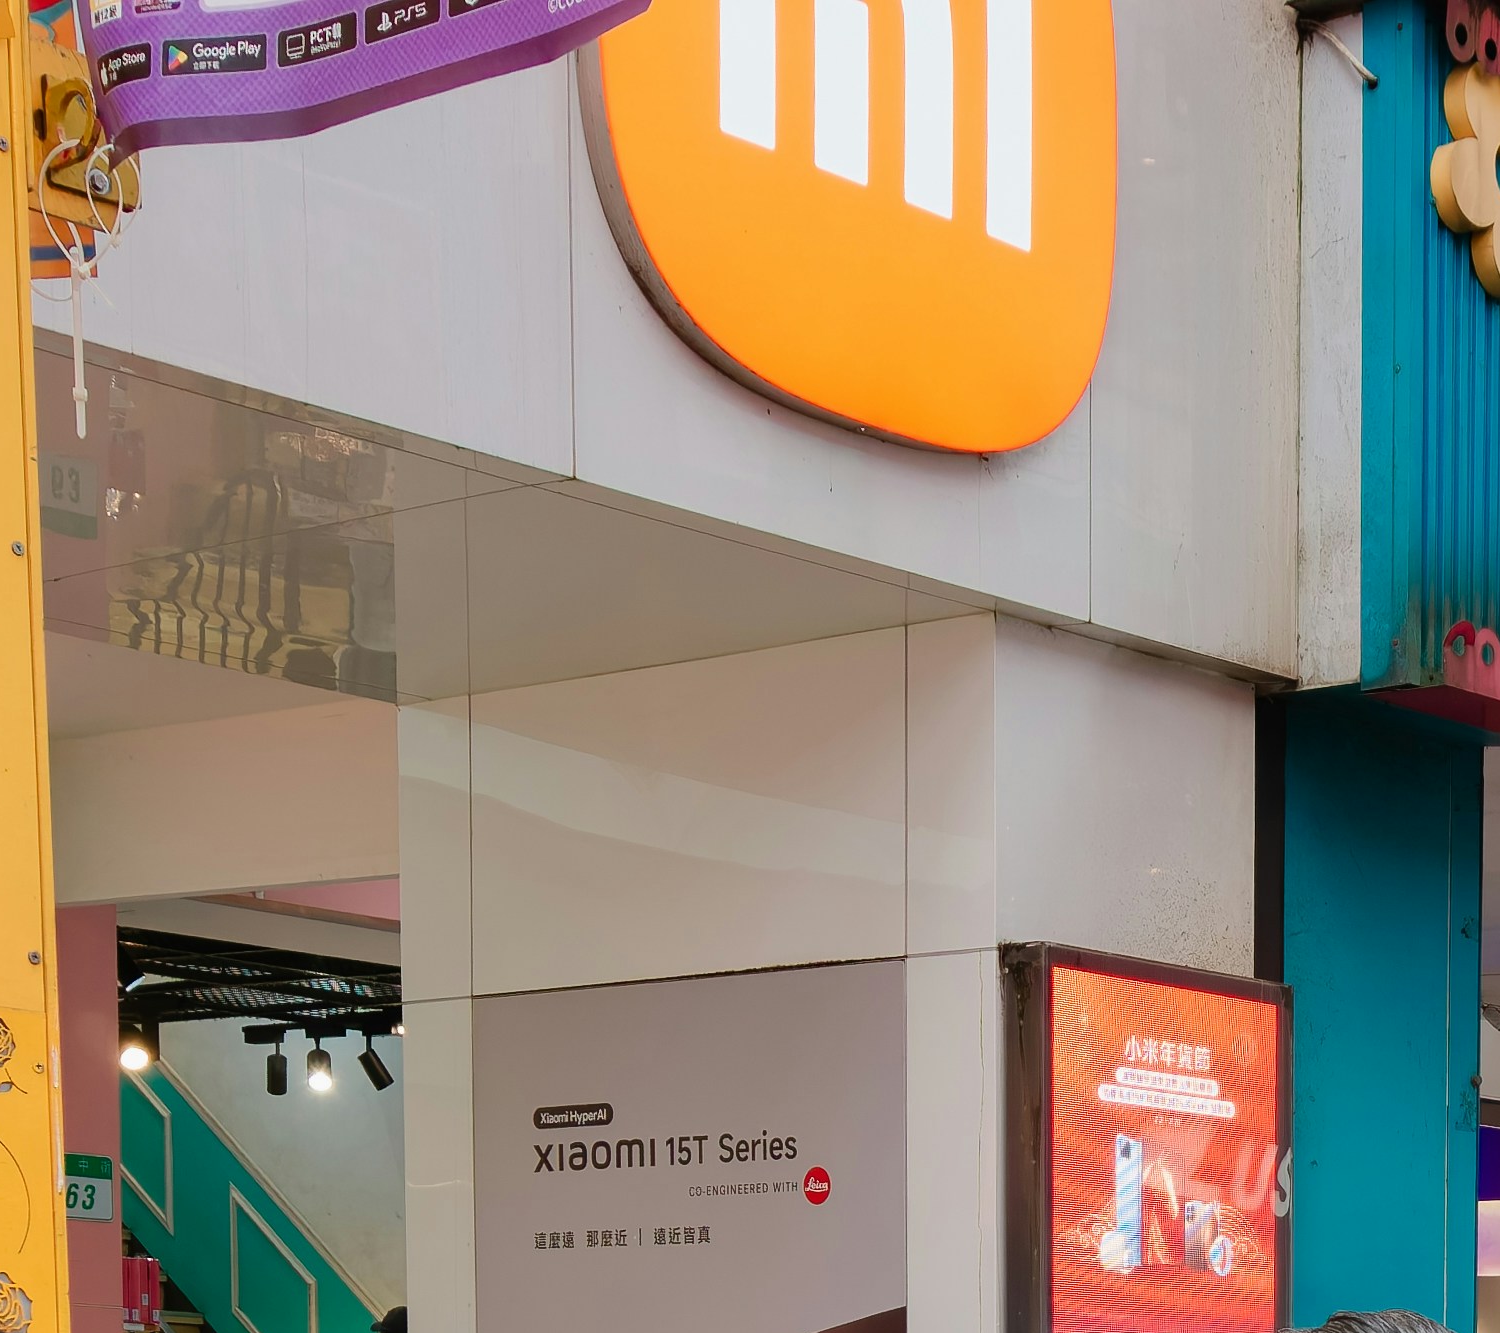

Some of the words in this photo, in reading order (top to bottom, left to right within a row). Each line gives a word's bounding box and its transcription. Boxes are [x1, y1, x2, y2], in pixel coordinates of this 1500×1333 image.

[394, 2, 427, 25] PS5
[309, 22, 342, 46] PC下載
[122, 51, 146, 66] Store
[193, 43, 235, 63] Google
[237, 41, 262, 61] Play
[540, 1111, 569, 1125] Xiaomi
[569, 1108, 607, 1125] HyperAI
[665, 1135, 709, 1166] 15T
[718, 1129, 798, 1164] Series
[689, 1182, 769, 1198] CO-ENGINEERED
[772, 1181, 798, 1194] WITH
[804, 1176, 830, 1194] Leica
[534, 1230, 575, 1250] 這麼遠
[586, 1228, 628, 1248] 那麼近
[653, 1225, 711, 1245] 遠近皆真
